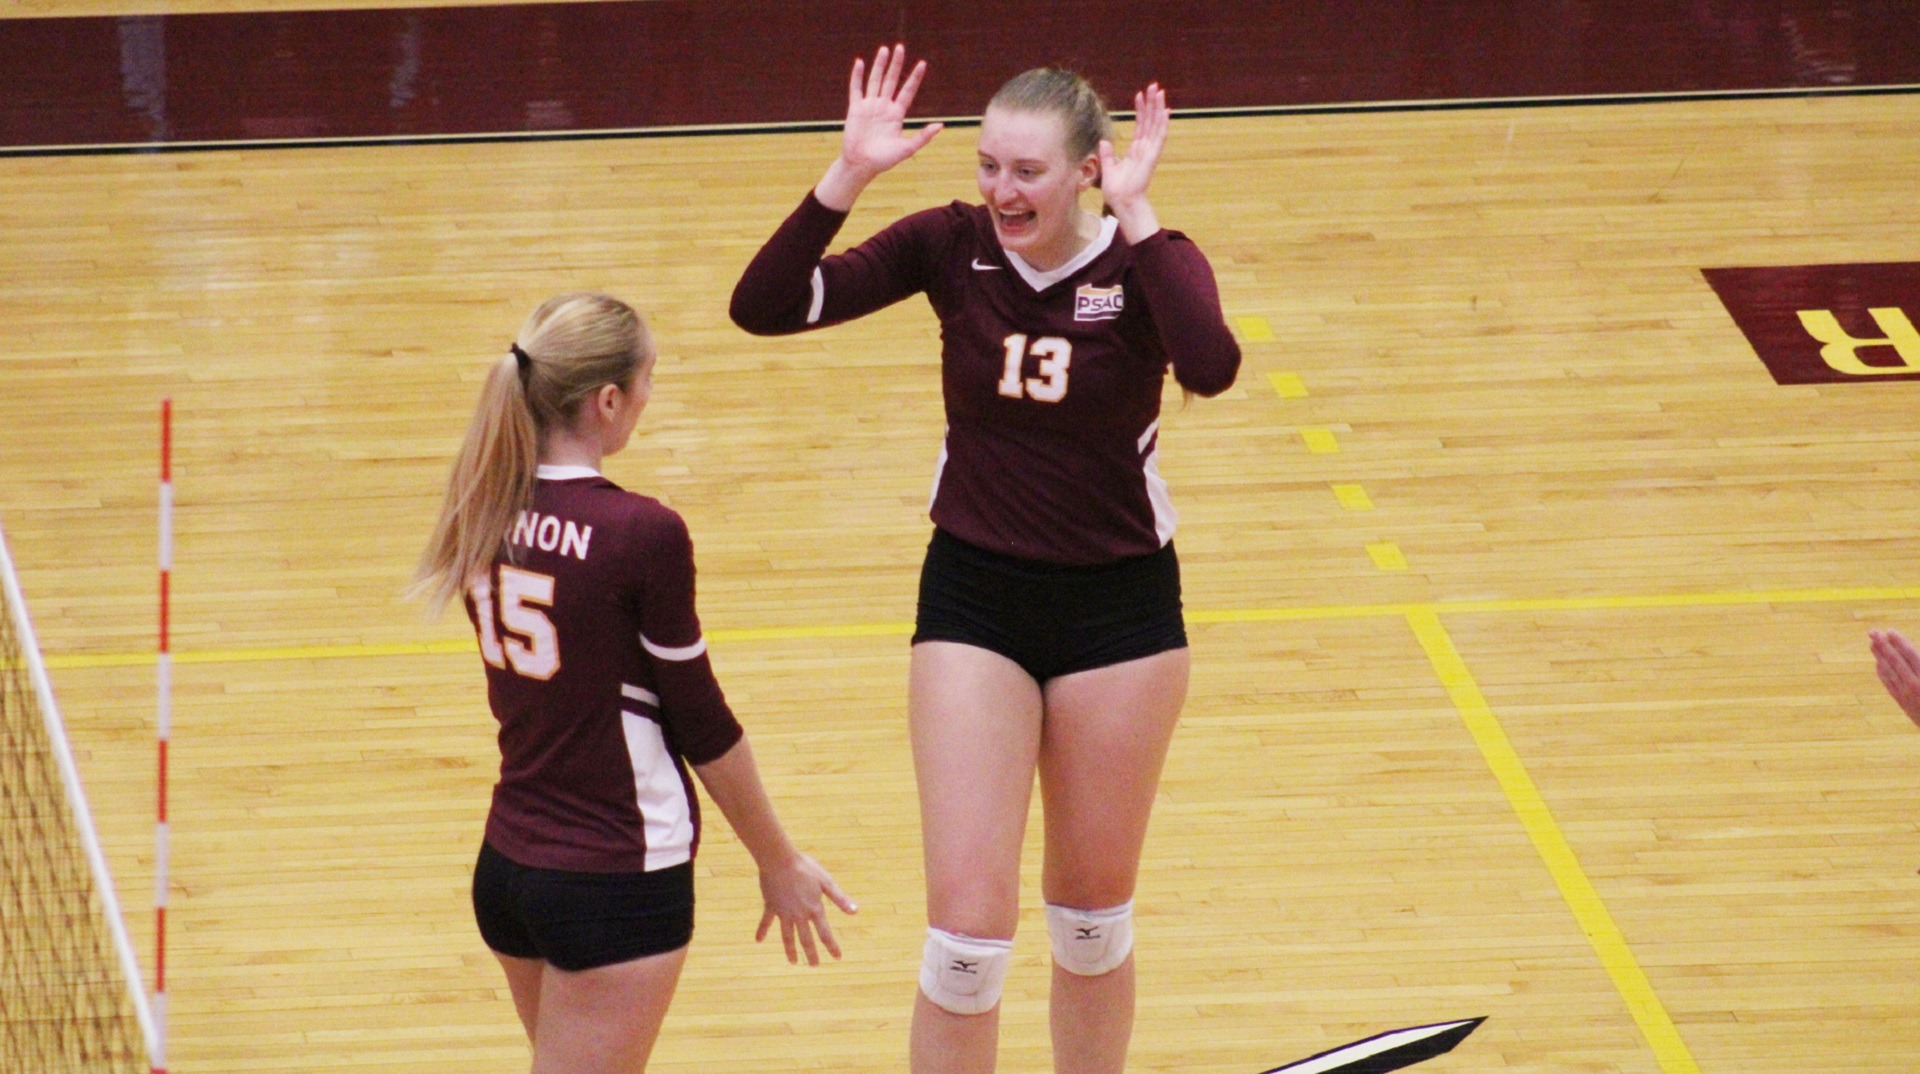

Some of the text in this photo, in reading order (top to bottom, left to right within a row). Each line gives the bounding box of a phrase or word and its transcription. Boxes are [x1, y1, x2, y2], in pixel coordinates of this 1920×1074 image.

[1076, 294, 1123, 312] PSAC
[998, 333, 1072, 403] 13
[510, 510, 593, 560] NON
[468, 563, 561, 681] 15
